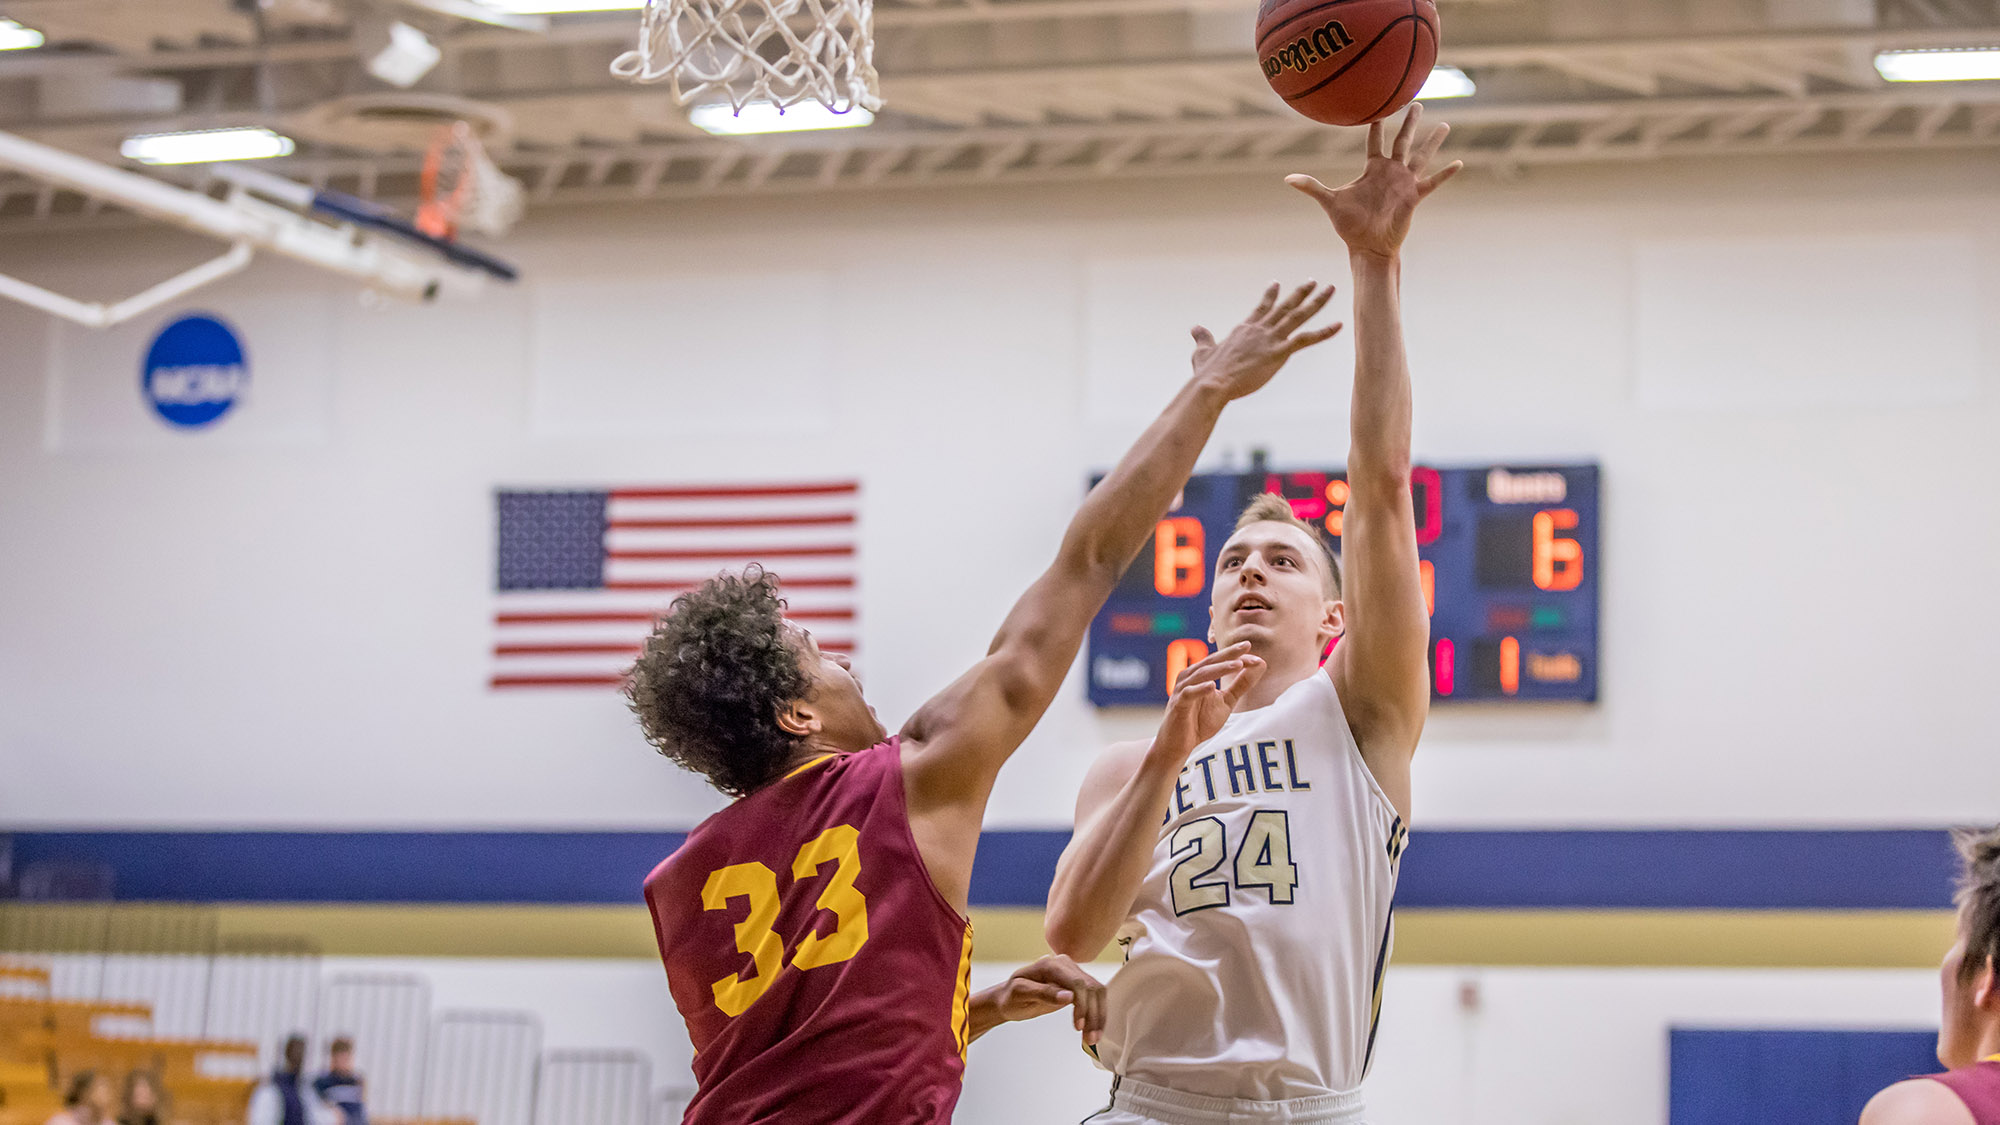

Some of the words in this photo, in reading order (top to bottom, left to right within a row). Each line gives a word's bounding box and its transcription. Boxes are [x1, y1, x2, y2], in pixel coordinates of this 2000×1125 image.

[1154, 516, 1206, 598] 8
[1532, 508, 1584, 592] 6
[1500, 636, 1520, 695] 1
[1162, 738, 1312, 828] ETHEL
[1169, 809, 1299, 918] 24
[700, 823, 869, 1018] 33
